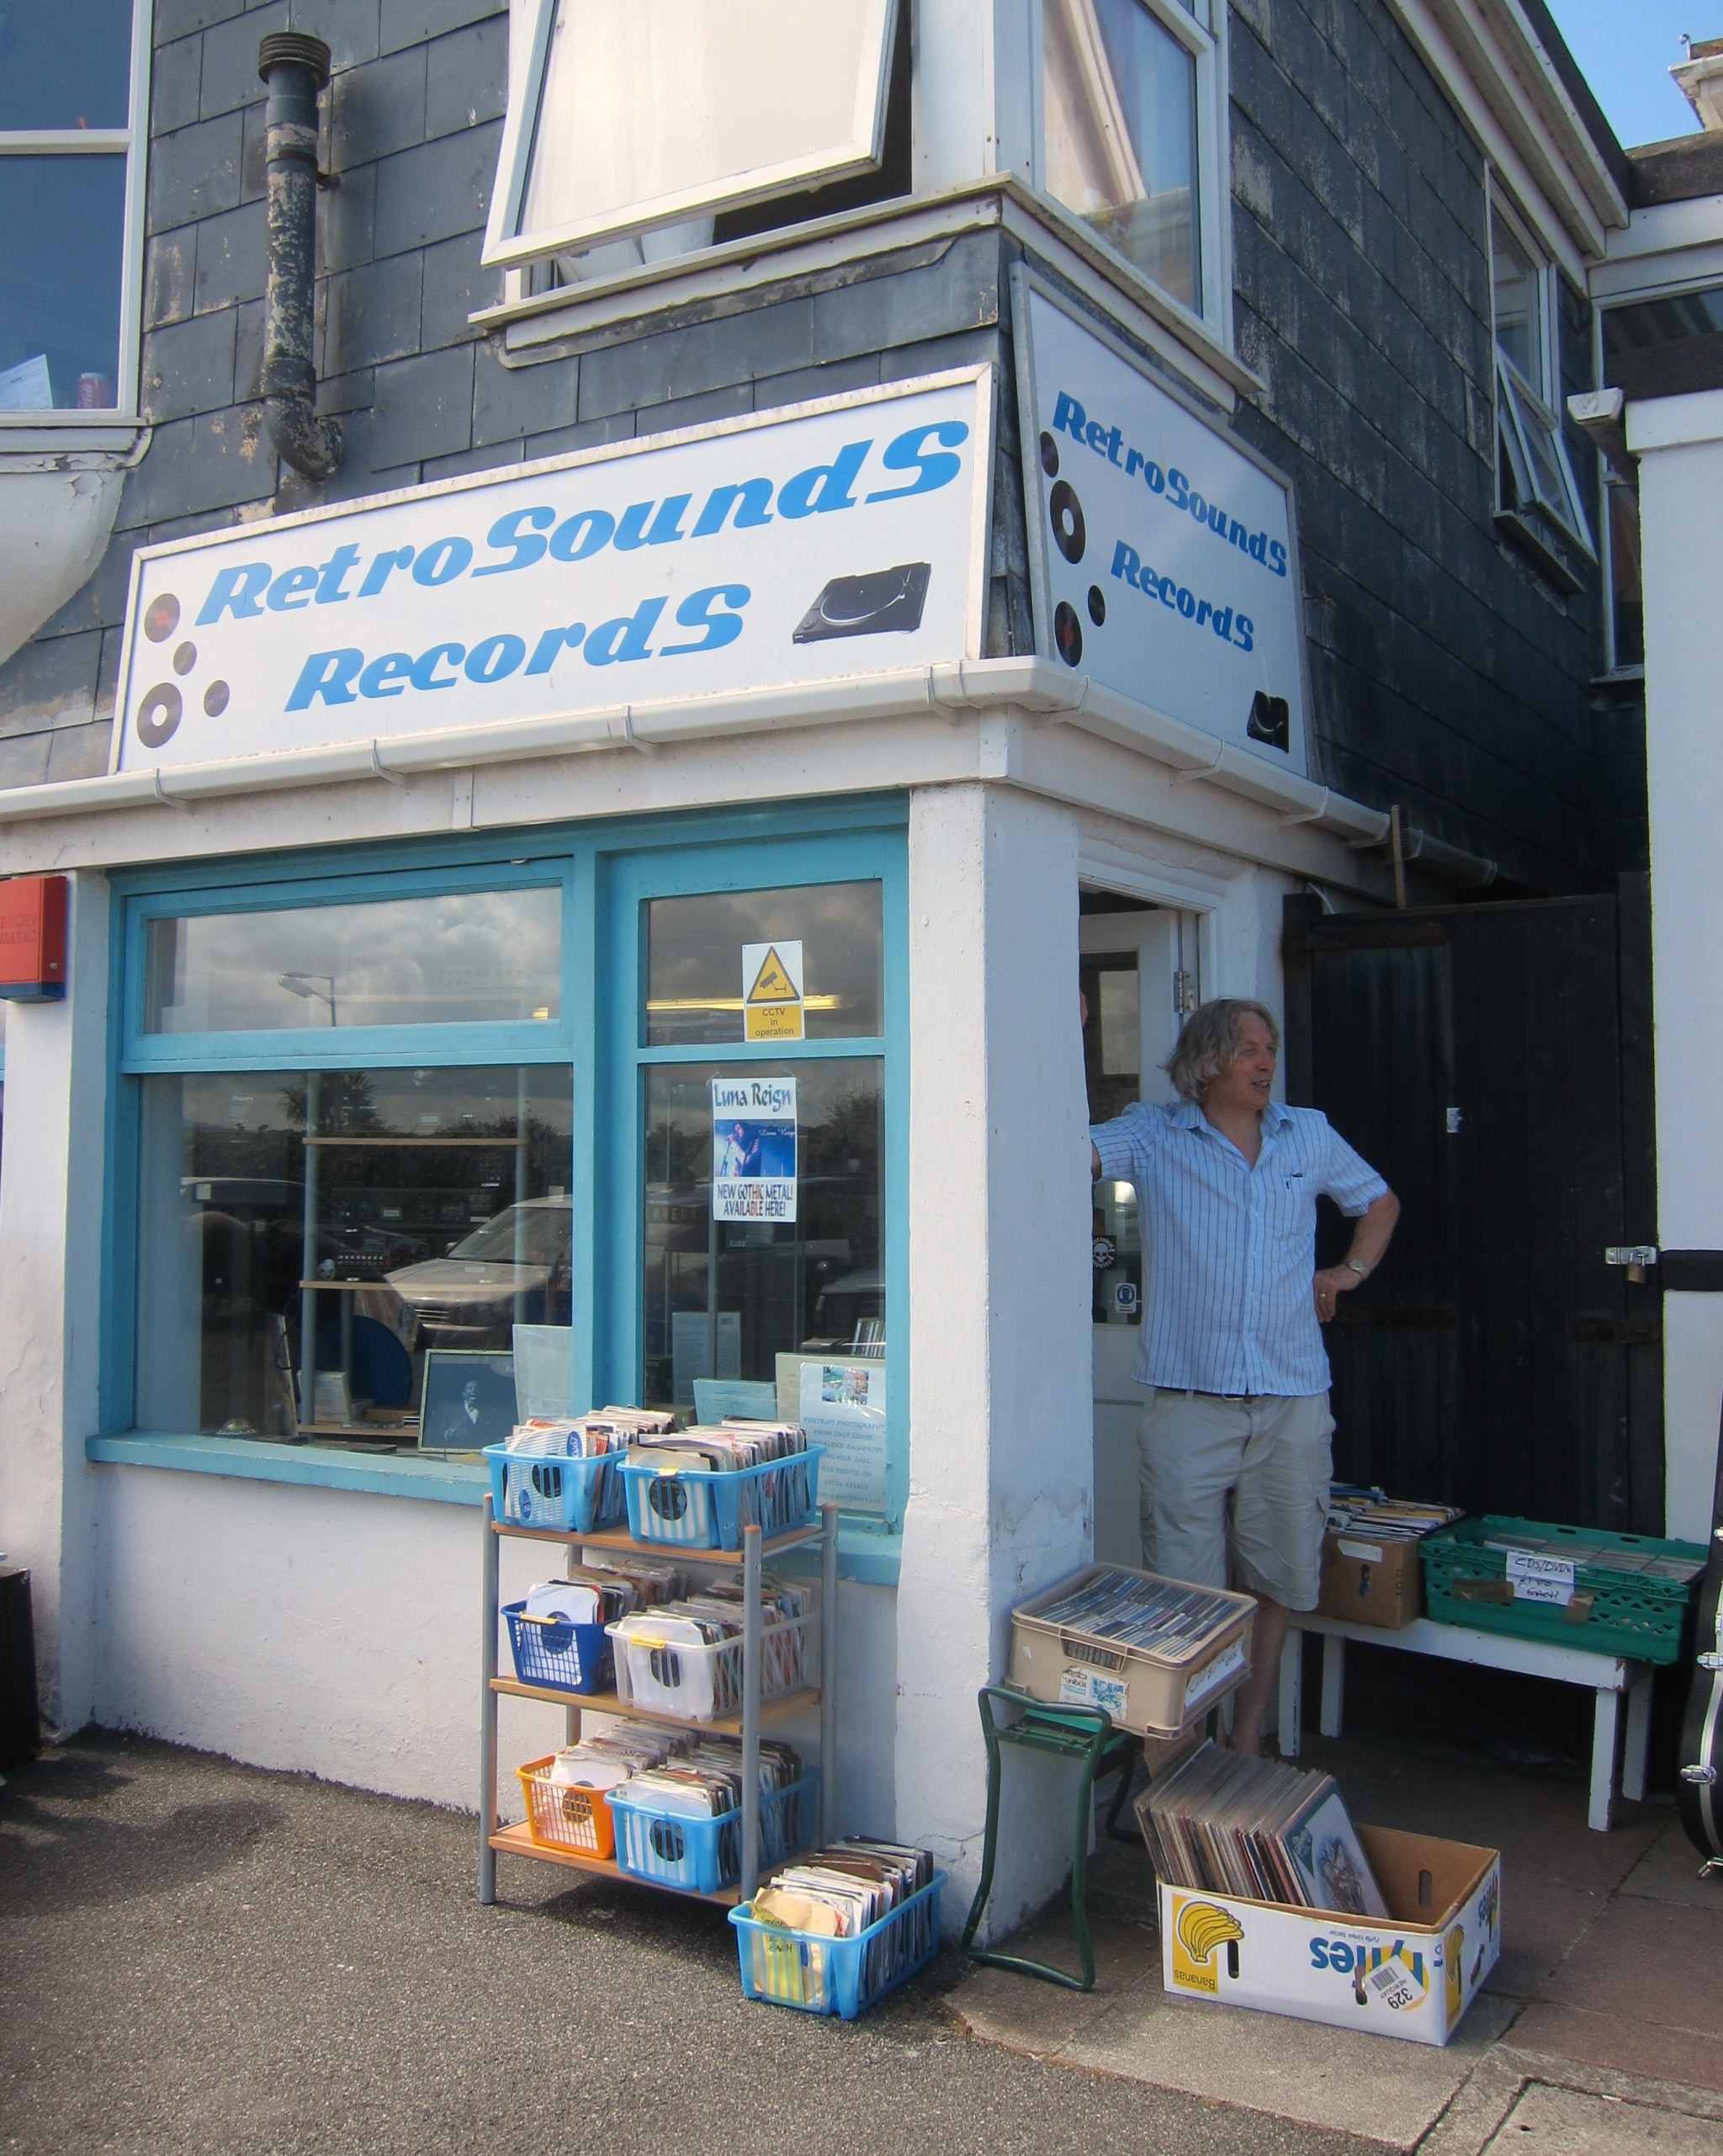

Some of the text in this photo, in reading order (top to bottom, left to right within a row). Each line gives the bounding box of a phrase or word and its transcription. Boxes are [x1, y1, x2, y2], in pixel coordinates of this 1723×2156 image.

[762, 1007, 786, 1017] CCTV
[755, 1027, 794, 1038] operation
[713, 1082, 791, 1113] Luna Reign
[717, 1183, 793, 1200] NEW GOTHIC METAL!
[724, 1201, 786, 1217] AVAILABLE HERE!
[803, 1417, 885, 1430] PORTRAIT PHOTOGRAPHY
[1173, 1969, 1217, 1990] Bananas
[1378, 1978, 1408, 2001] NEWQUAY
[1388, 1987, 1413, 2010] 329
